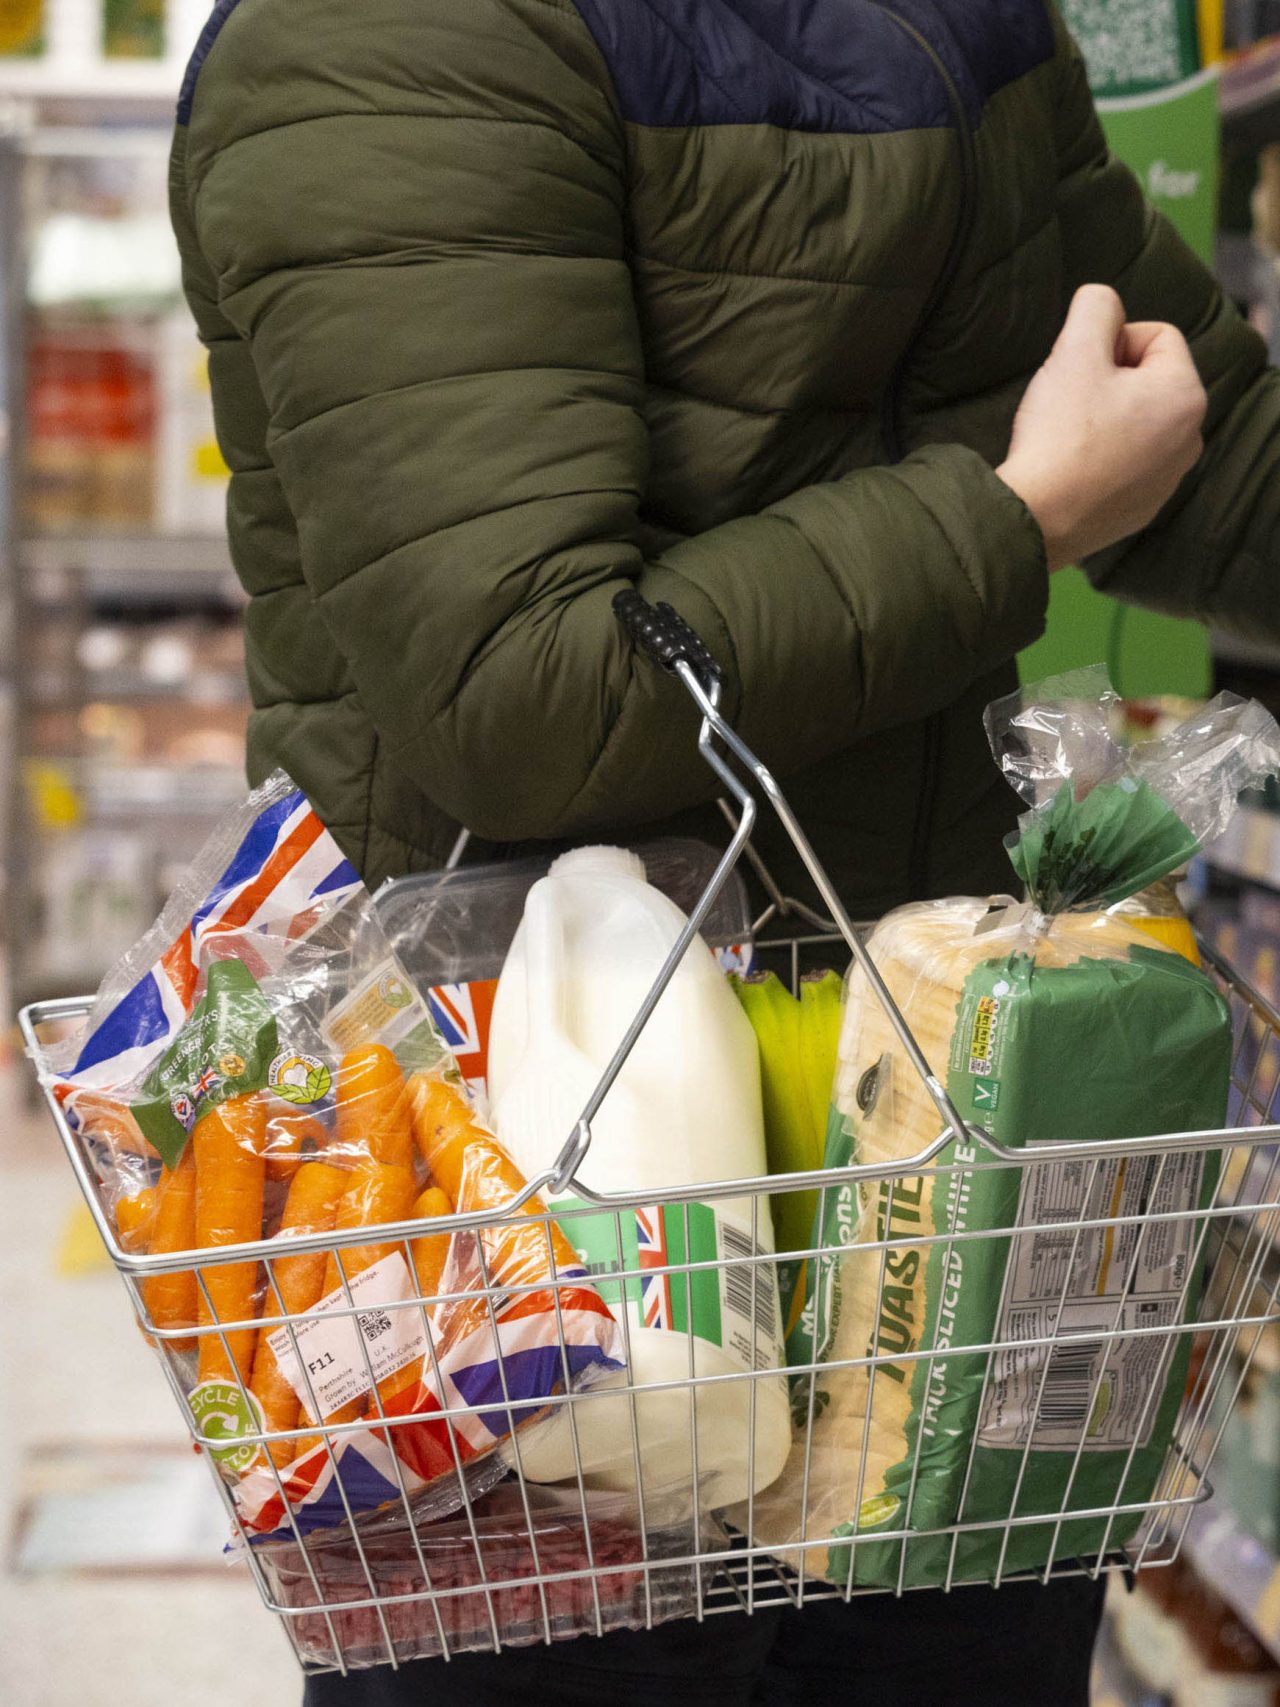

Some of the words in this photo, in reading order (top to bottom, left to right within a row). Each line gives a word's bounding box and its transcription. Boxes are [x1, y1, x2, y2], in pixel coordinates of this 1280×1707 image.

[990, 1083, 999, 1109] VEGAN
[866, 1176, 925, 1384] TOASTIE
[831, 1287, 842, 1329] EXPERT
[938, 1249, 963, 1352] SLICED
[307, 1351, 336, 1375] F11
[318, 1366, 354, 1393] Perthshire
[325, 1387, 347, 1403] Grown
[347, 1380, 357, 1391] by
